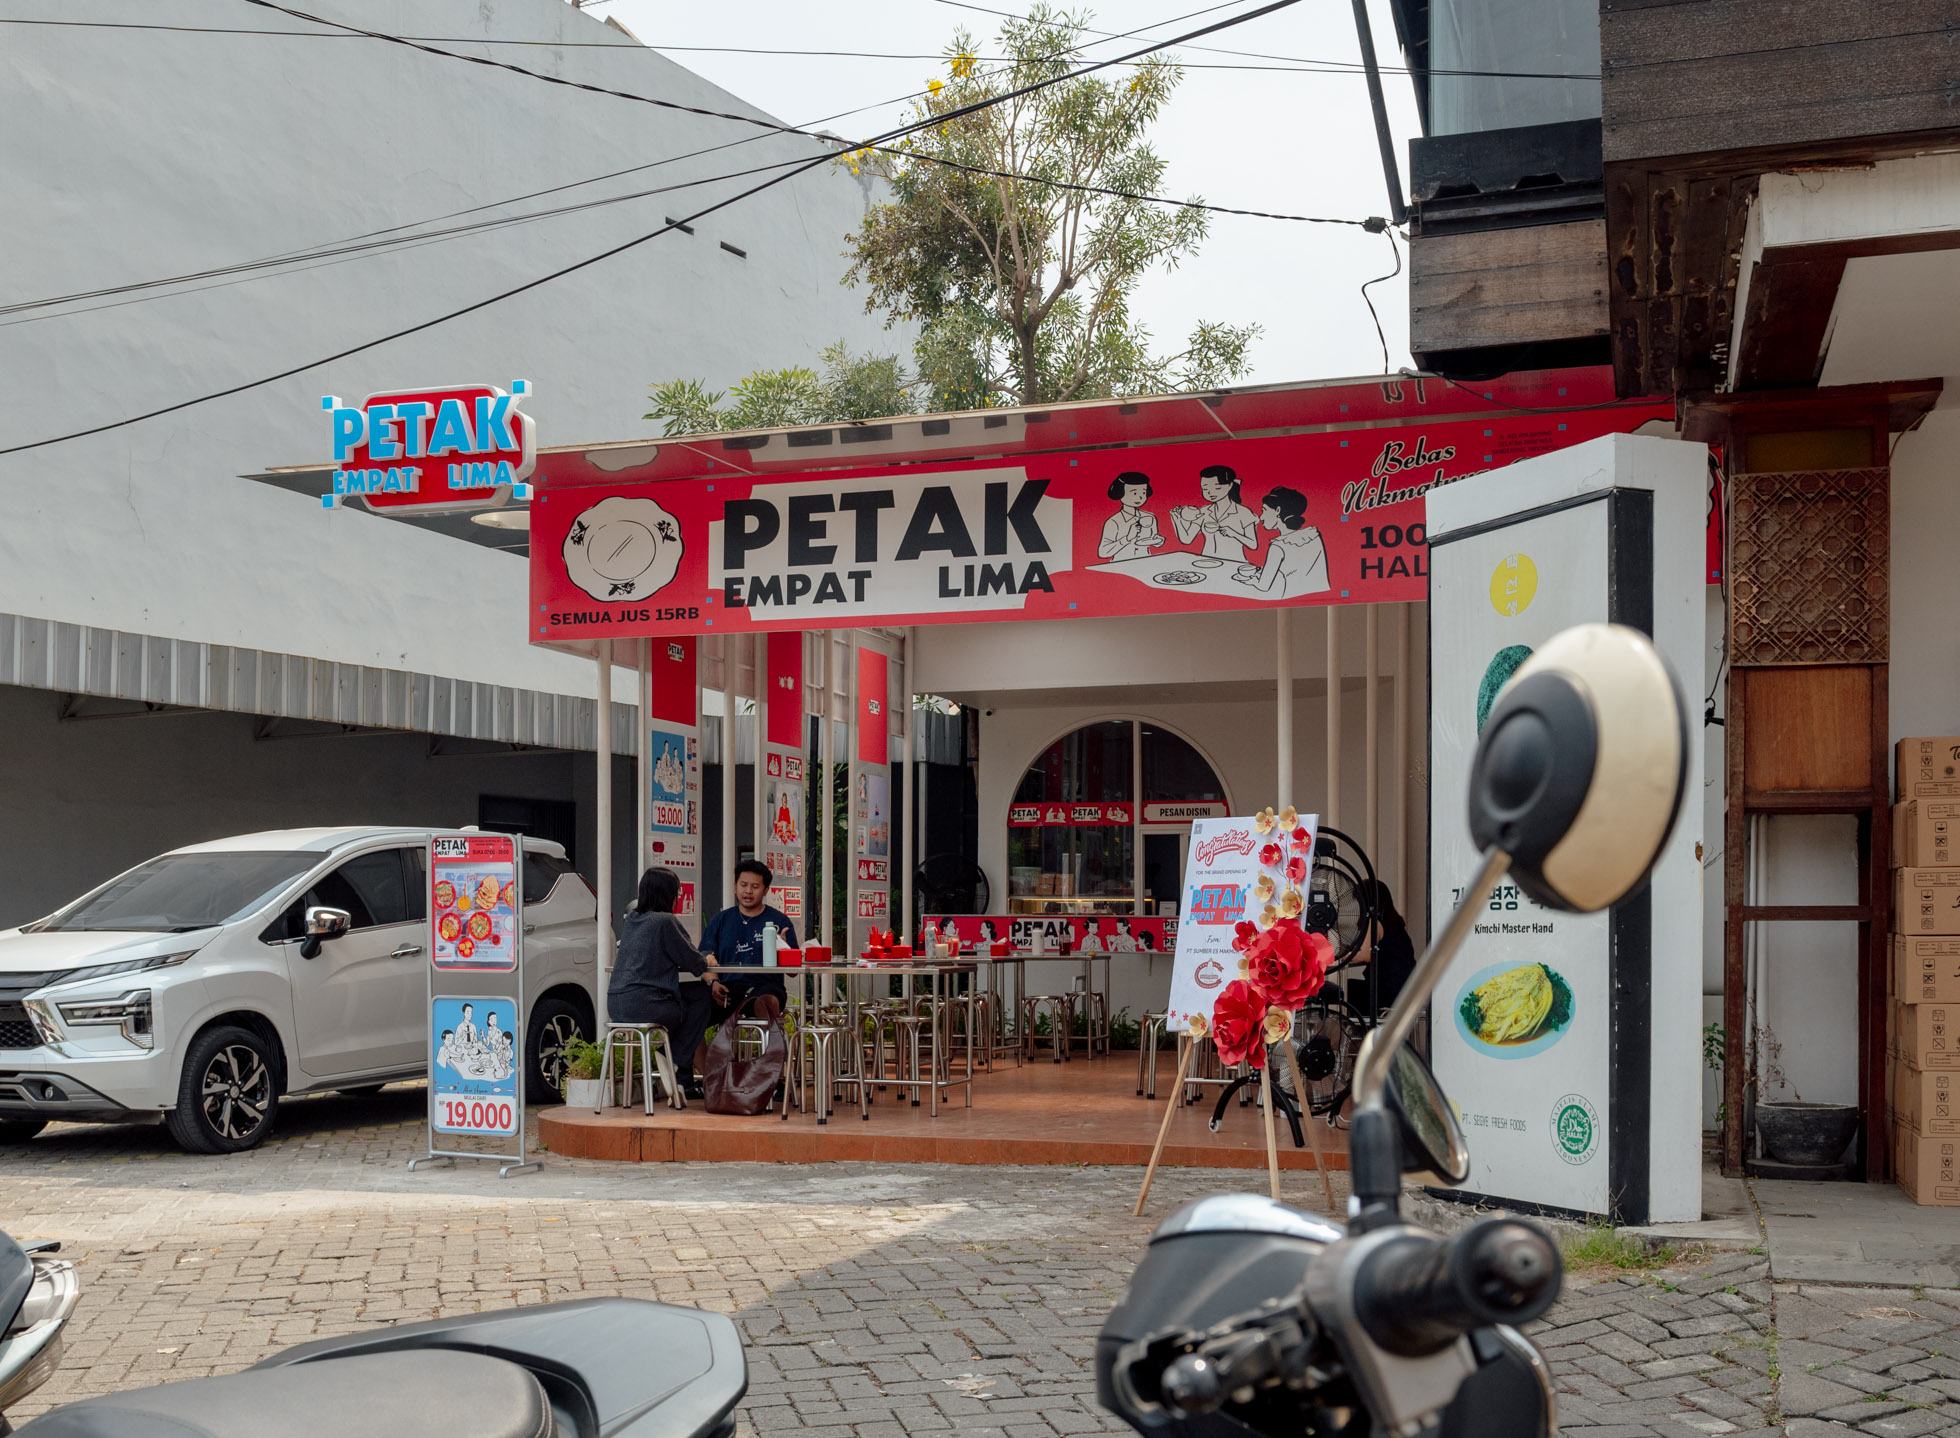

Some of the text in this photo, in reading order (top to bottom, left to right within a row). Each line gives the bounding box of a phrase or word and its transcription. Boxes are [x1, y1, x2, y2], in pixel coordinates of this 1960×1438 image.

[333, 395, 518, 461] PETAK
[1371, 436, 1456, 477] Bebas
[333, 460, 514, 494] EMPAT LIMA
[723, 479, 1052, 570] PETAK
[724, 561, 1055, 608] EMPAT LIMA
[550, 607, 699, 626] SEMUA JUS 15RB
[657, 806, 682, 826] 19.000
[1012, 809, 1038, 817] PETAK
[1073, 808, 1099, 816] PETAK
[1160, 807, 1210, 816] PESAN DISINI
[435, 840, 467, 850] PETAK
[1191, 888, 1247, 909] PETAK
[1190, 911, 1243, 921] EMPAT LIMA
[1475, 922, 1554, 934] Kimchi Master Hand
[1051, 938, 1059, 946] LI
[446, 1101, 511, 1129] 19.000
[1462, 1113, 1470, 1125] PT.
[1491, 1116, 1507, 1129] FRESH
[1510, 1118, 1526, 1131] FOODS
